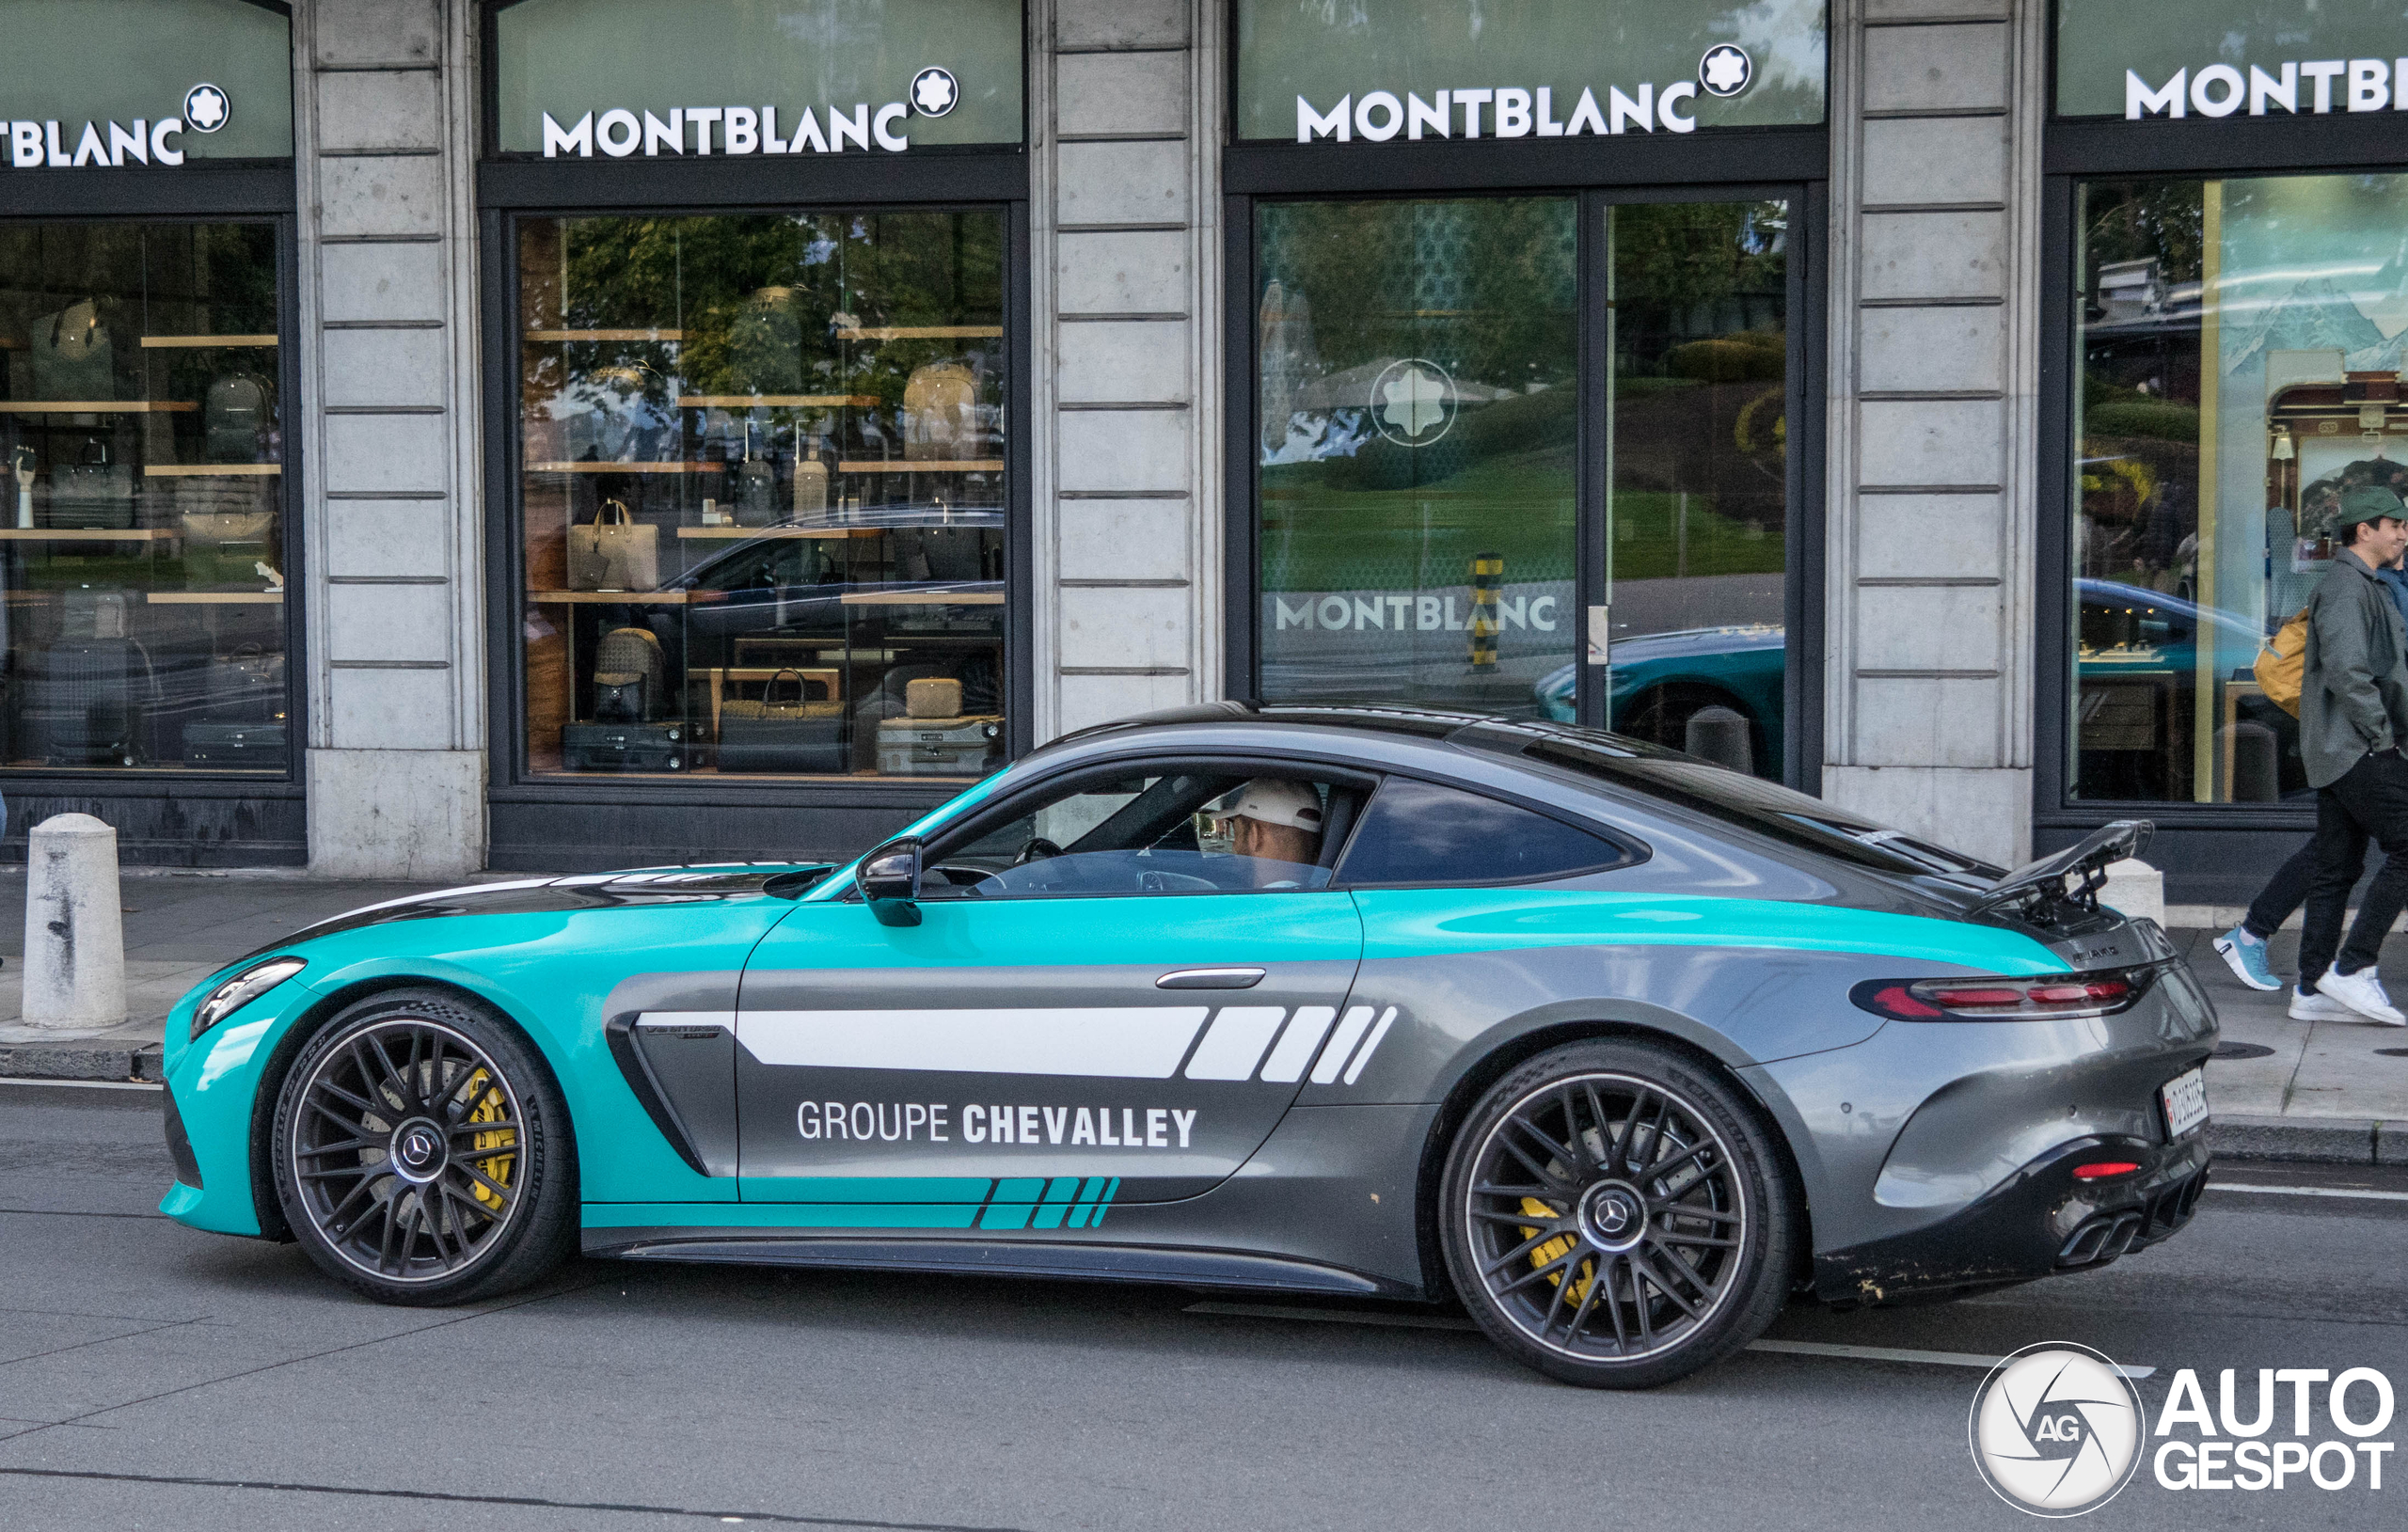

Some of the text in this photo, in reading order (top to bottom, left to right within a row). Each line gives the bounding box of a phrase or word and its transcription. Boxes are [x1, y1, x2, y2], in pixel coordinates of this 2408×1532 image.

[543, 103, 909, 158] MONTBLANC
[1297, 82, 1696, 143] MONTBLANC
[1275, 595, 1556, 632] MONTBLANC
[797, 1100, 1197, 1147] GROUPE CHEVALLEY
[529, 1117, 545, 1199] MICHELIN
